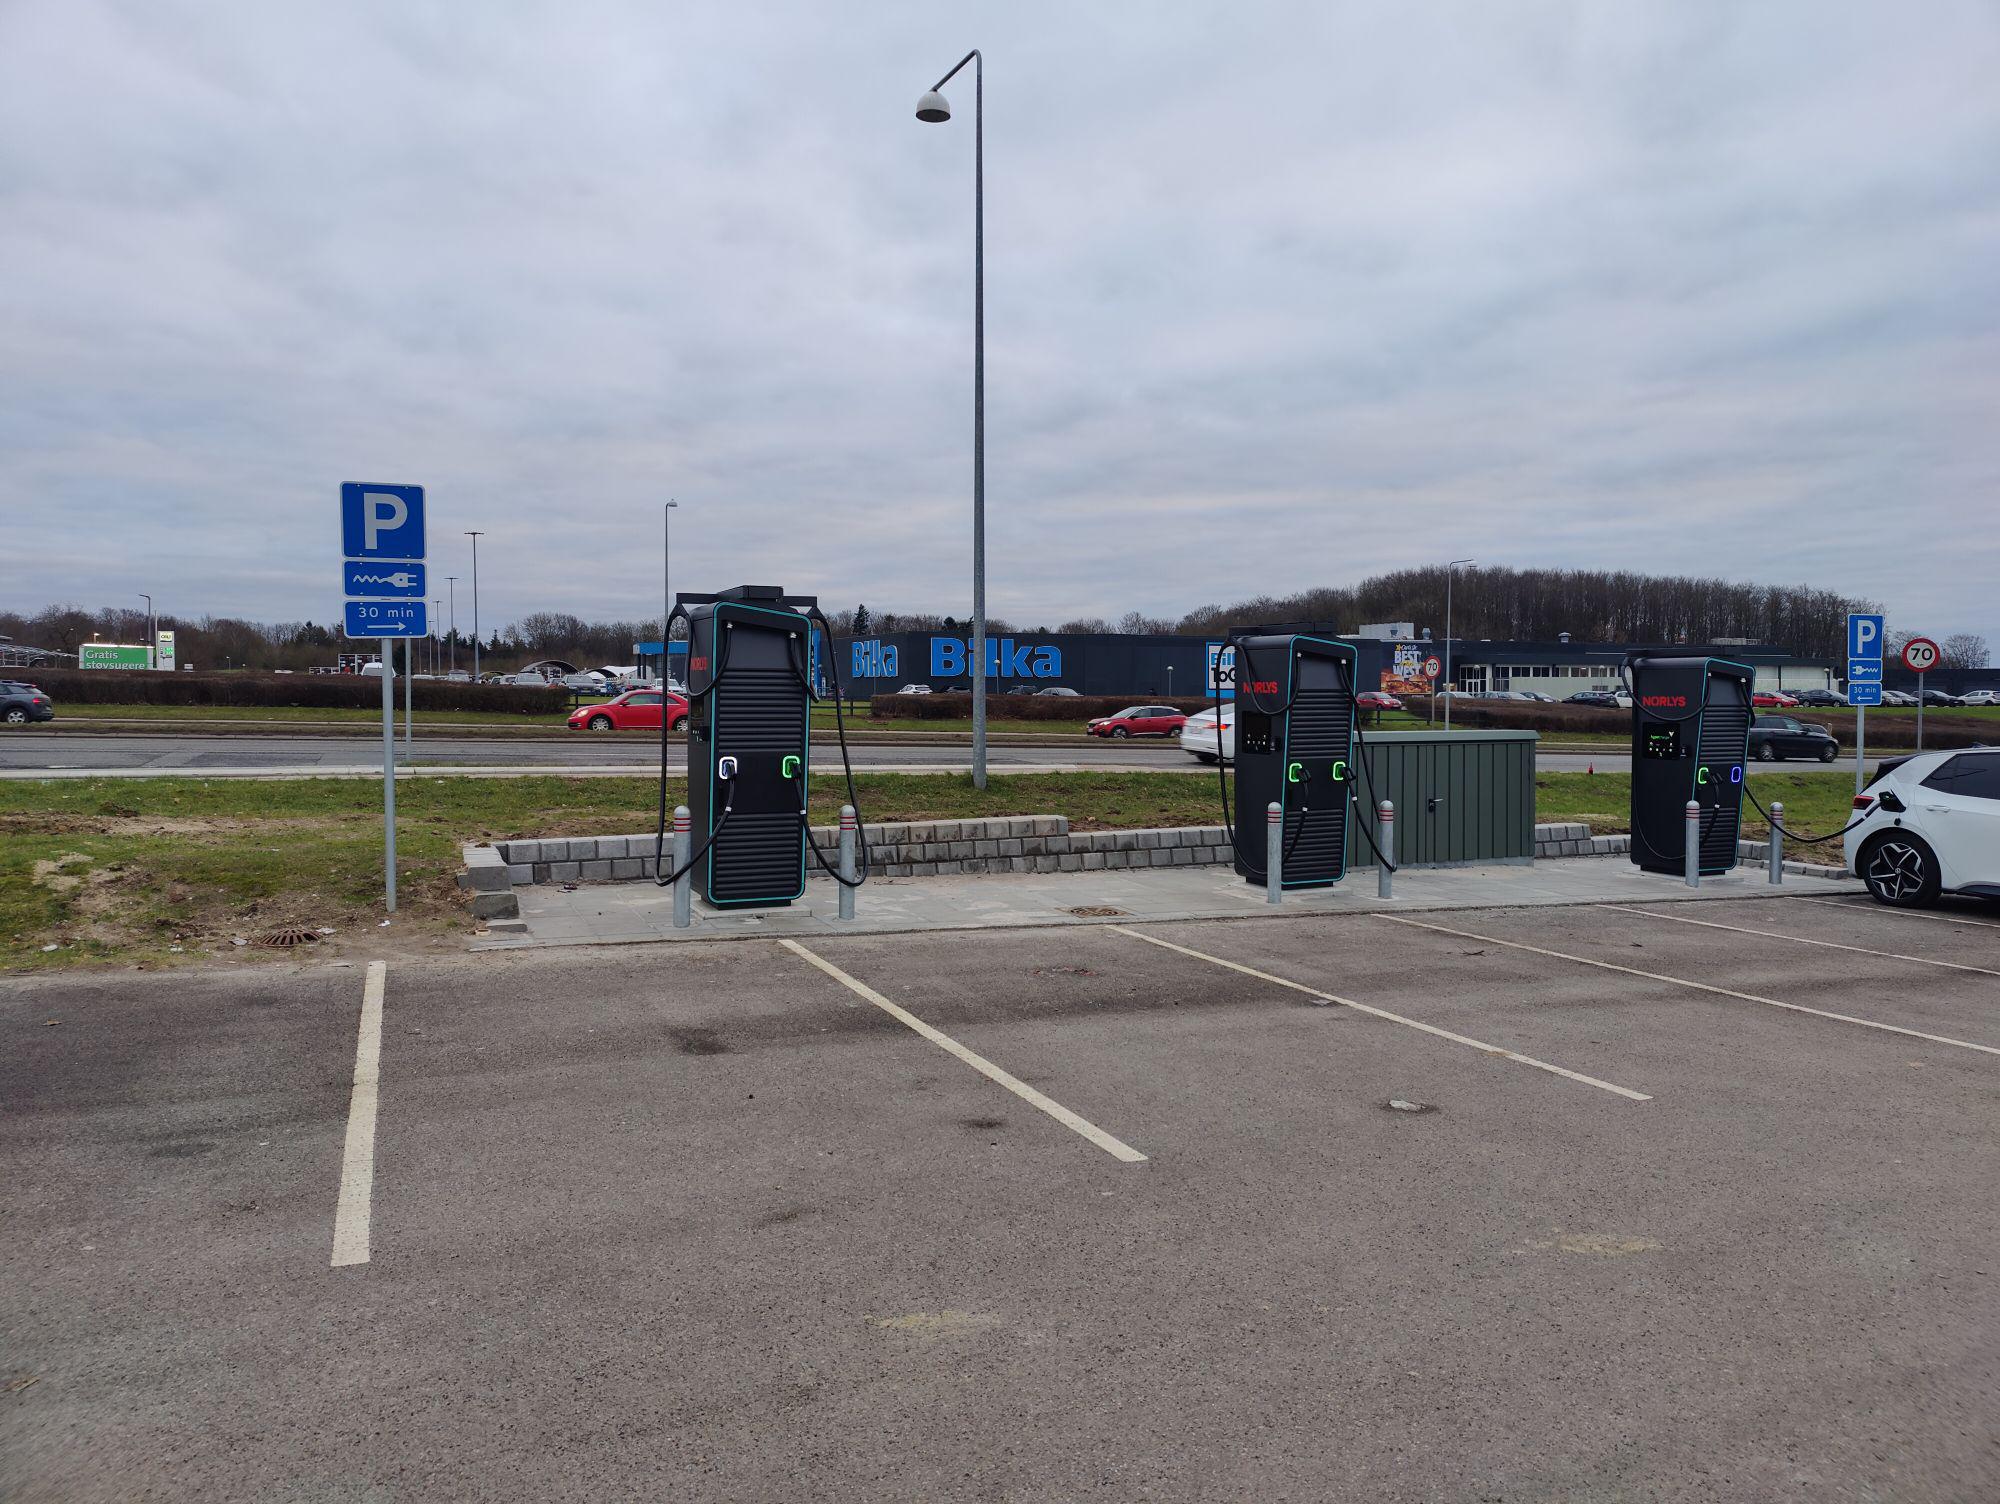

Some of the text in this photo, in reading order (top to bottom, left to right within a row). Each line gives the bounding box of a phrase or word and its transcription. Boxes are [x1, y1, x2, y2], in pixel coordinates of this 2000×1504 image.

[363, 492, 408, 550] P
[358, 606, 414, 618] 30 min
[1857, 620, 1877, 654] P
[85, 650, 119, 659] Gratis
[852, 639, 899, 678] Bilka
[1394, 650, 1421, 664] BEST
[1911, 648, 1933, 661] 70
[86, 660, 146, 671] støvsugere
[1427, 662, 1438, 671] 70
[1392, 665, 1421, 679] WEST
[1854, 686, 1877, 694] 30 min
[1642, 696, 1687, 708] NORLYS
